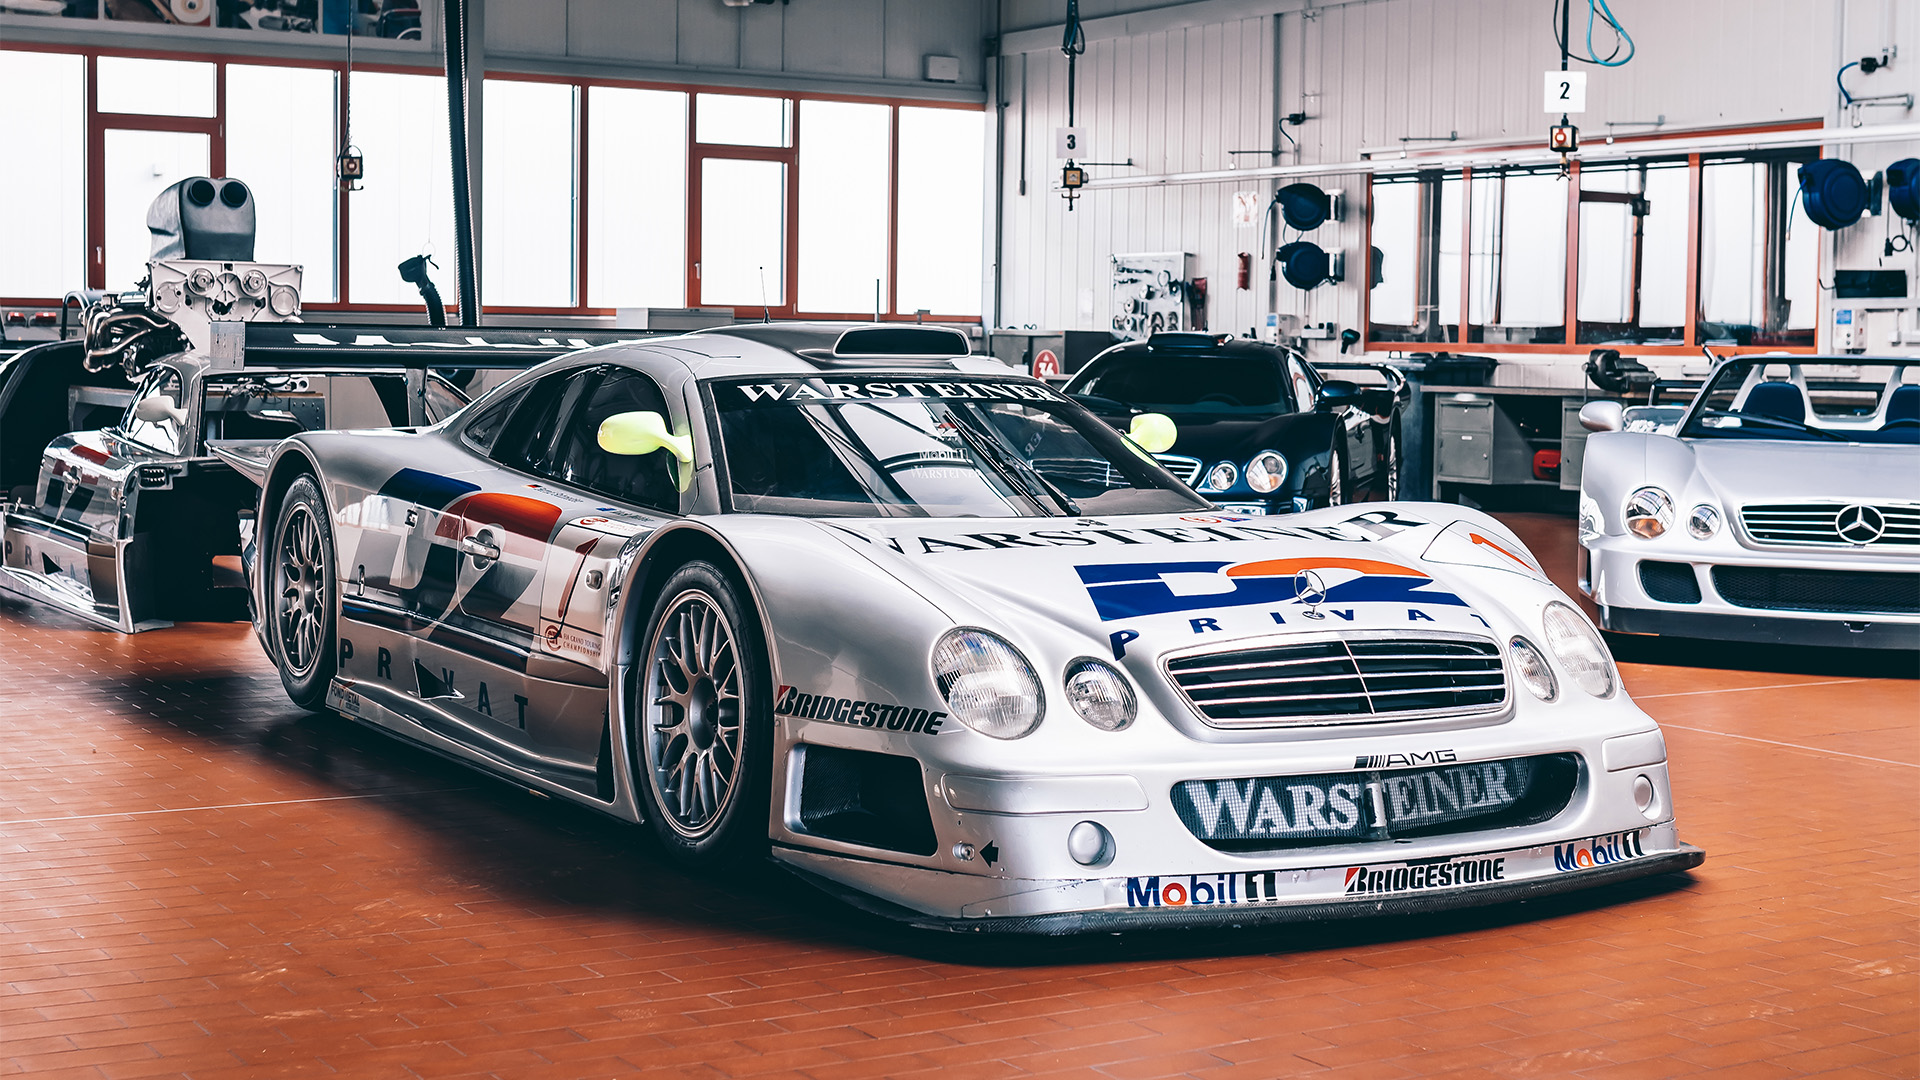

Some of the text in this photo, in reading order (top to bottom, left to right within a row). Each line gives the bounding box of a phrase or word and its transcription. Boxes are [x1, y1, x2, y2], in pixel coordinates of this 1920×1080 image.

[1560, 81, 1570, 99] 2
[1067, 134, 1076, 150] 3
[737, 382, 1066, 403] WARSTEINER
[774, 685, 948, 735] BRIDGESTONE
[1386, 749, 1456, 767] AMG
[1184, 761, 1516, 837] WARSTEINER
[1554, 831, 1643, 872] Mobil 1
[1127, 872, 1271, 907] Mobil 1
[1345, 858, 1504, 896] BRIDGESTONE
